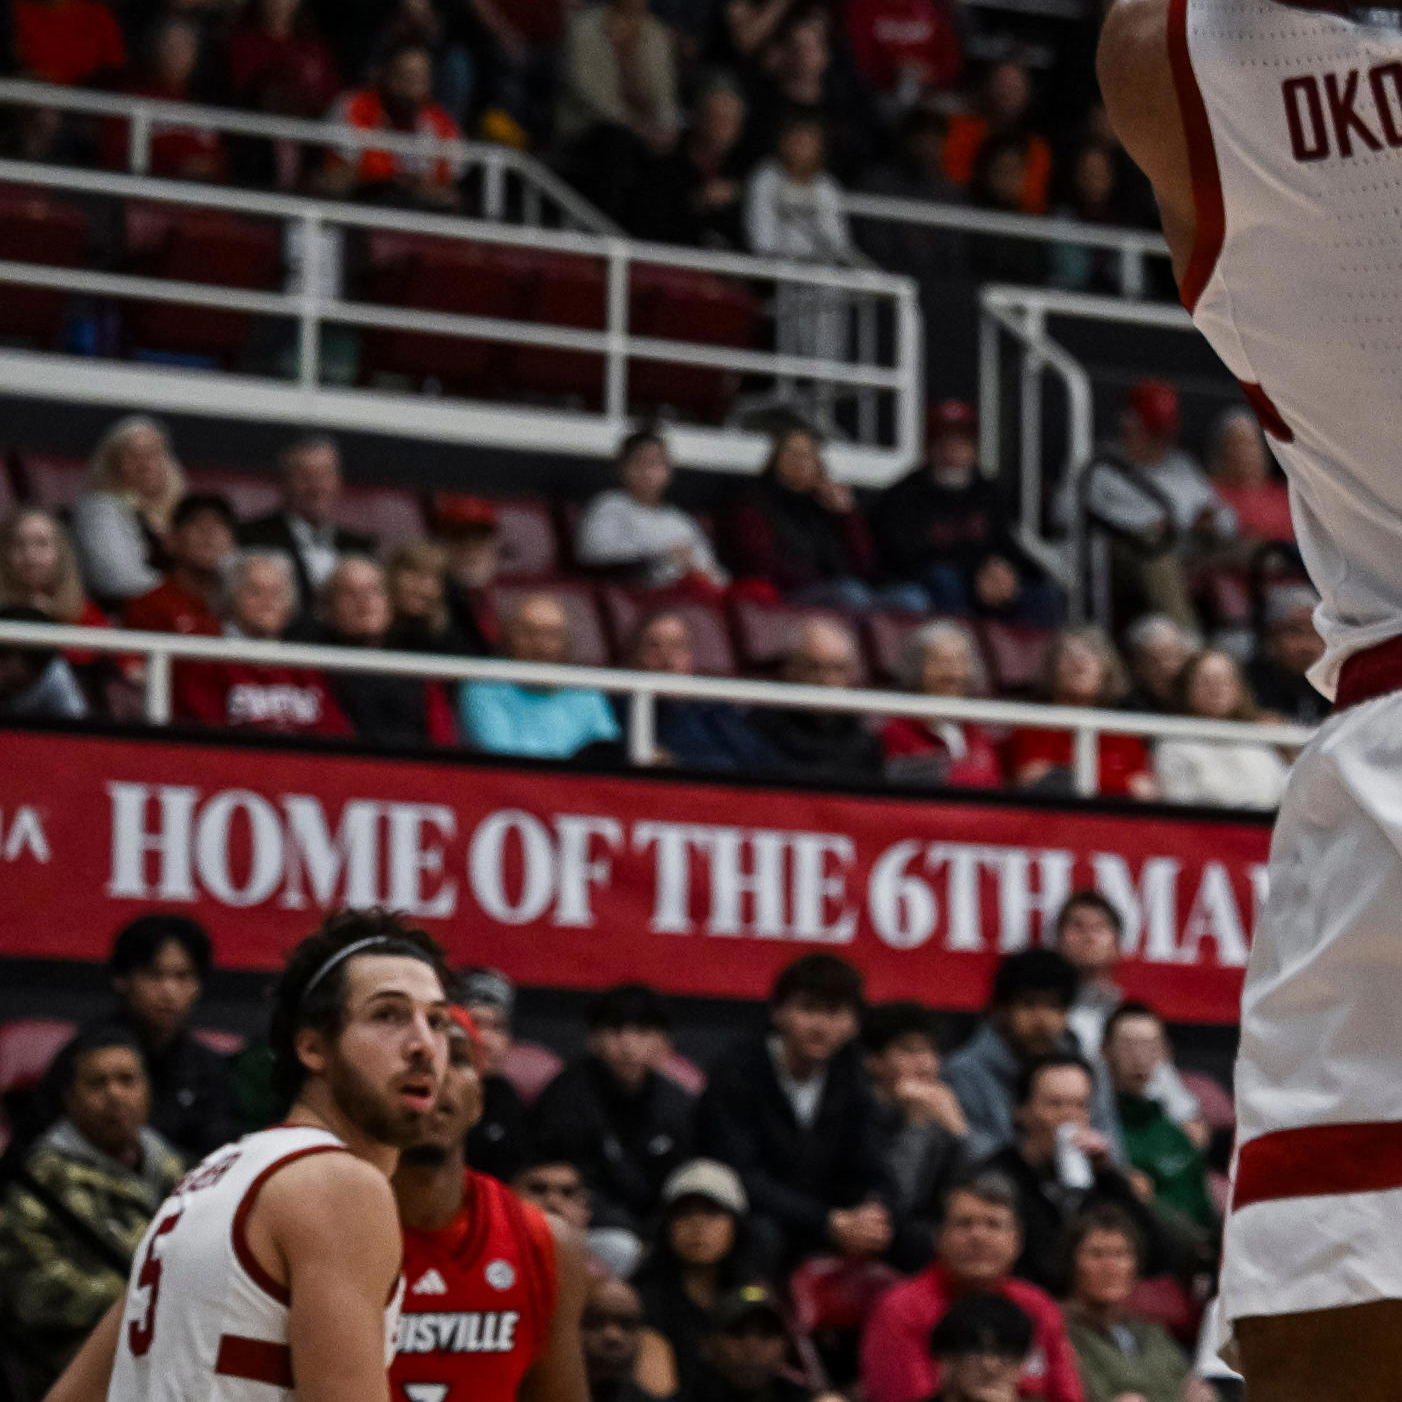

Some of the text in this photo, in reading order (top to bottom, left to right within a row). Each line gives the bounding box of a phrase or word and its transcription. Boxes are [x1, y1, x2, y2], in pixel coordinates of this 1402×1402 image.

[104, 780, 458, 918] HOME
[466, 808, 622, 928] OF
[634, 820, 858, 944] THE
[868, 838, 1074, 954] 6TH
